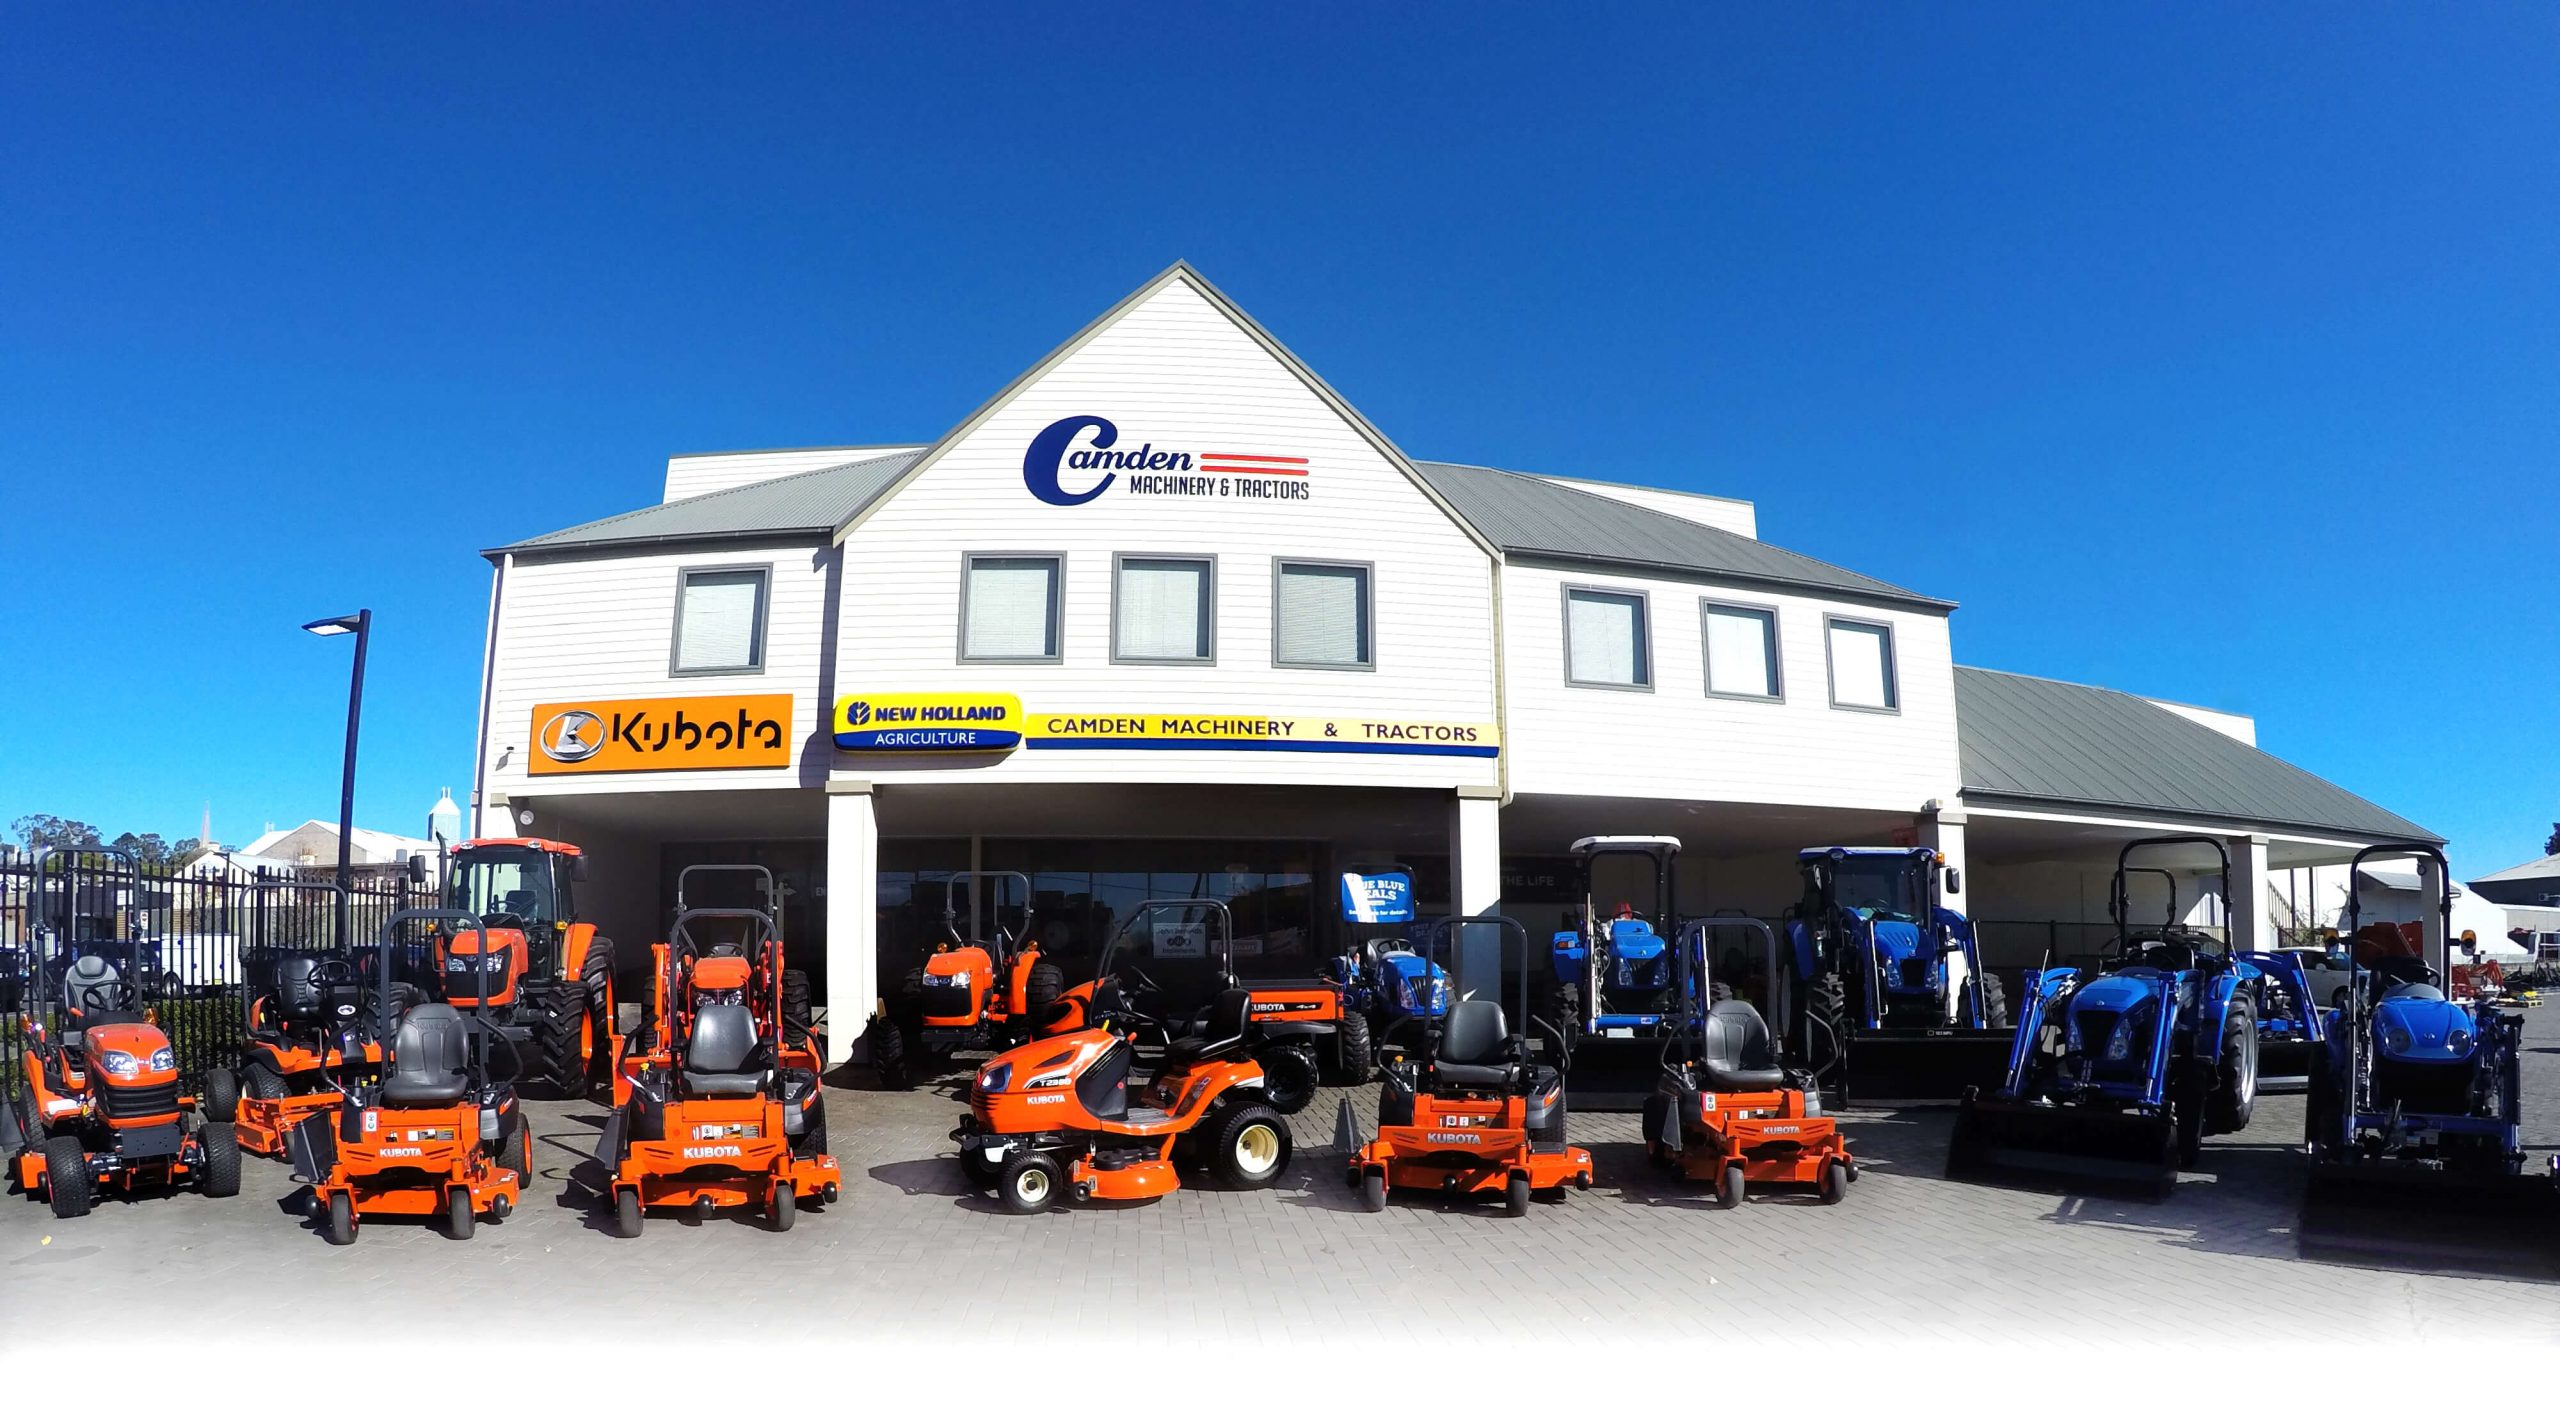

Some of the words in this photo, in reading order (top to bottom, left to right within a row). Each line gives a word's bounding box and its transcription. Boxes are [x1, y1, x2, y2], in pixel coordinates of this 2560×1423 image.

[1023, 415, 1193, 506] Camden
[1130, 475, 1216, 497] MACHINERY
[1220, 478, 1230, 497] &
[1235, 478, 1310, 500] TRACTORS
[875, 707, 917, 722] NEW
[921, 706, 1006, 721] HOLLAND
[612, 708, 782, 752] Kubota
[1047, 718, 1145, 734] CAMDEN
[1161, 719, 1295, 736] MACHINERY
[1324, 722, 1338, 737] &
[1361, 723, 1477, 742] TRACTORS
[875, 732, 976, 745] AGRICULTURE
[1378, 880, 1405, 892] BLUE
[1527, 875, 1555, 886] LIFE
[1366, 889, 1397, 901] EALS
[1251, 1003, 1286, 1012] UBOTA
[1027, 1095, 1066, 1104] KUBOTA
[1763, 1126, 1800, 1135] KUBOTA
[1427, 1133, 1482, 1144] KUBOTA
[379, 1148, 423, 1158] KUBOTA
[683, 1146, 742, 1158] KUBOTA
